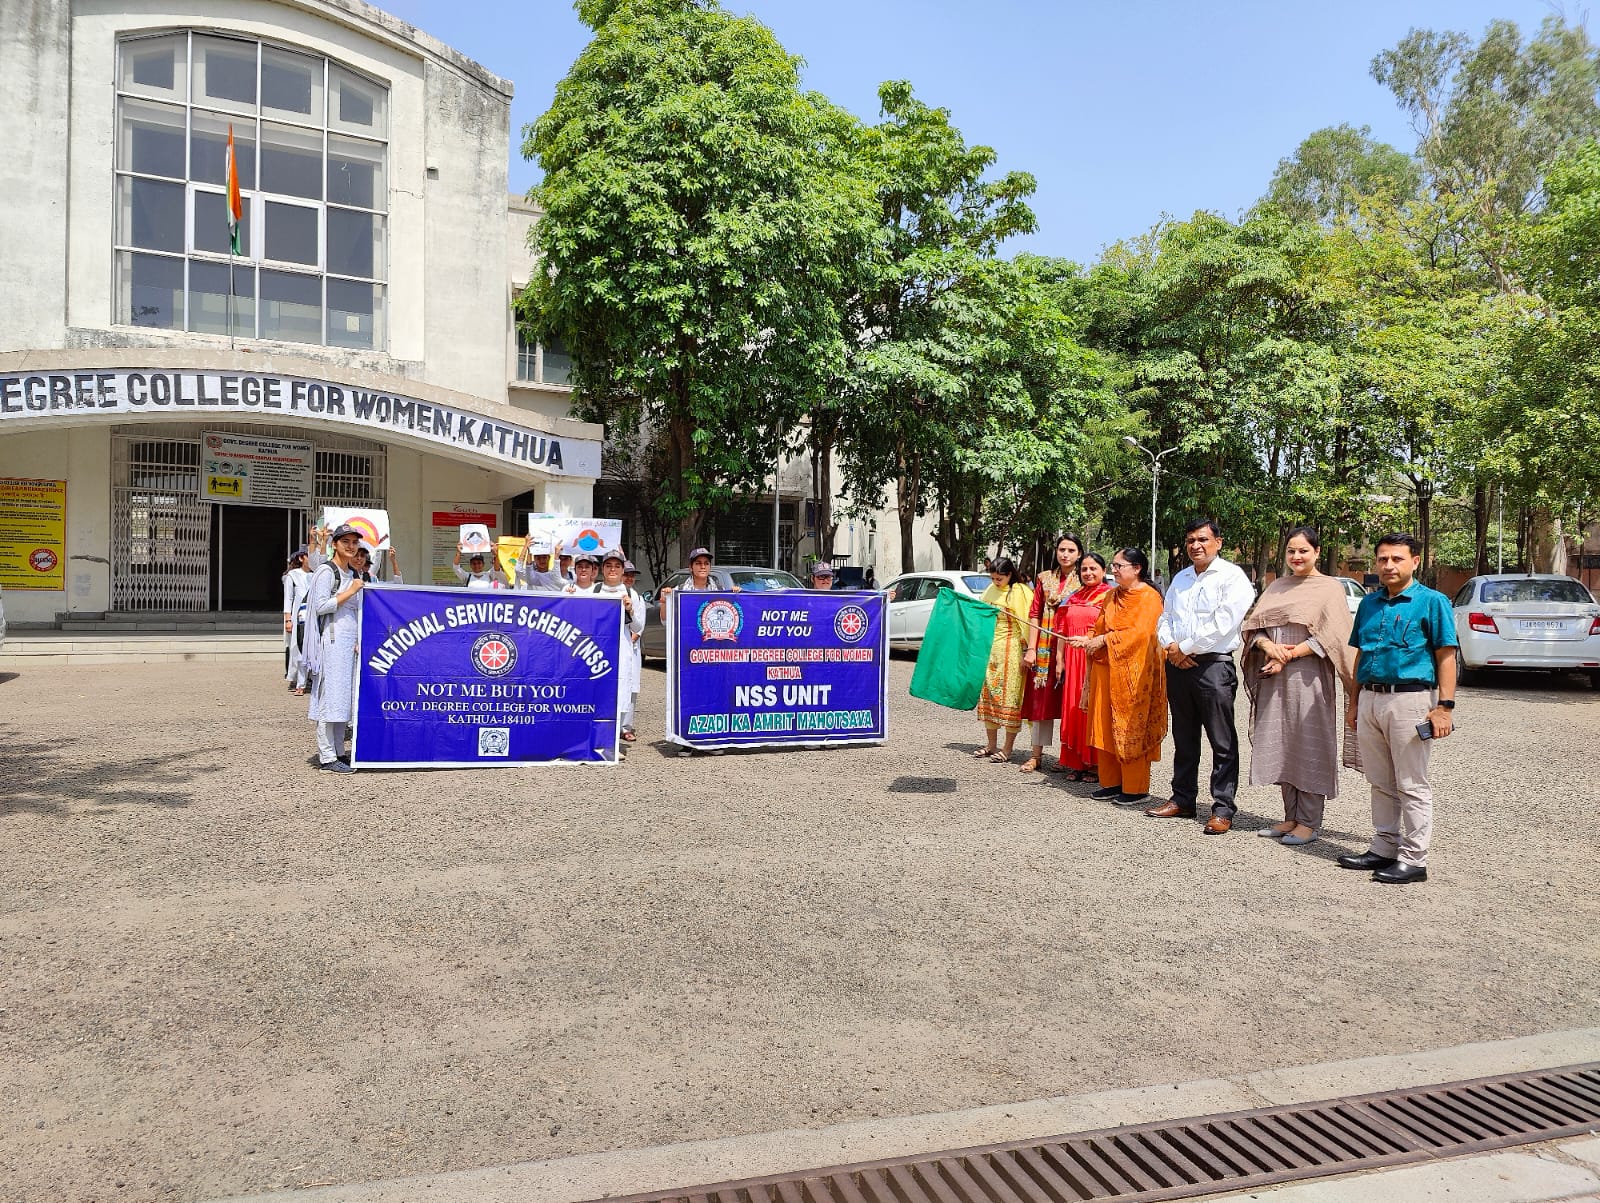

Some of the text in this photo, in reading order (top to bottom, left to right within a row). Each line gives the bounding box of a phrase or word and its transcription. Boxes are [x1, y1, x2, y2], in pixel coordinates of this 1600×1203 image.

[0, 374, 117, 412] EGREE
[126, 373, 281, 408] COLLEGE
[291, 381, 346, 415] FOR
[761, 610, 809, 622] NOT ME
[757, 625, 812, 637] BUT YOU
[368, 602, 613, 680] NATIONAL SERVICE SCHEME (NSS)
[690, 649, 873, 663] GOVERNMENT DEGREE COLLEGE FOR WOMEN
[767, 667, 802, 680] KATHUA
[417, 682, 567, 699] NOT ME BUT YOU
[735, 685, 832, 707] NSS UNIT
[381, 701, 596, 714] GOVT. DEGREE COLLEGE FOR WOMEN
[447, 714, 536, 725] KATHUA-184101
[688, 710, 874, 735] AZADI KA AMRIT MAHOTSAVA
